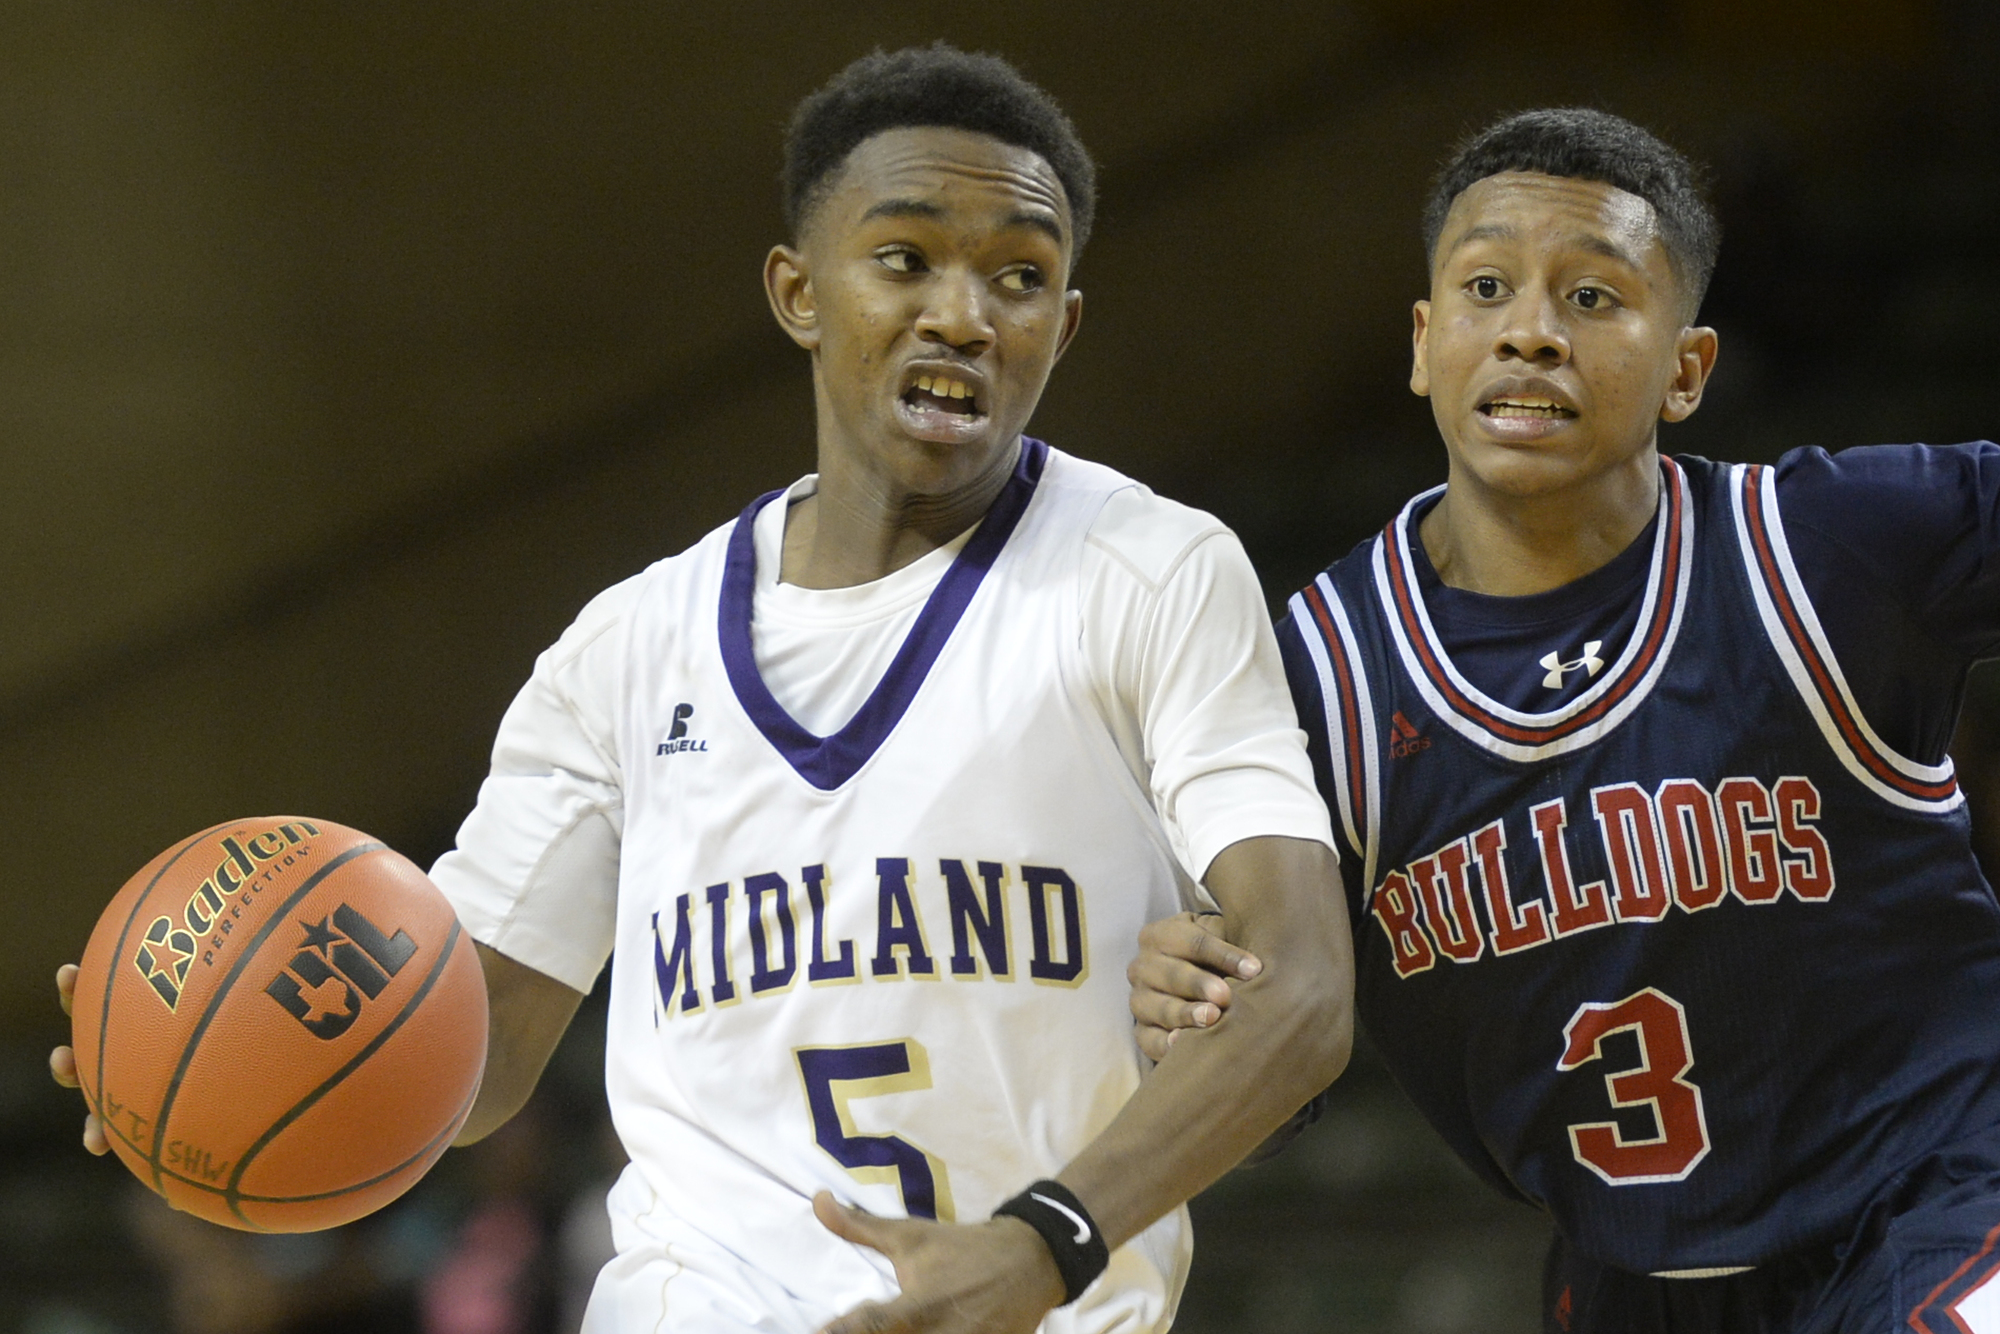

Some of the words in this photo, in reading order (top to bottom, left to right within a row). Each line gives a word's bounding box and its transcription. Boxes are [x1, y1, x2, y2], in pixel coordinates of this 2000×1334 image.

[134, 821, 322, 1014] Baden
[203, 845, 311, 967] PERFECTION
[652, 857, 1089, 1028] MIDLAND
[1372, 776, 1835, 979] BULLDOGS
[790, 1037, 956, 1223] 5
[1556, 986, 1711, 1187] 3
